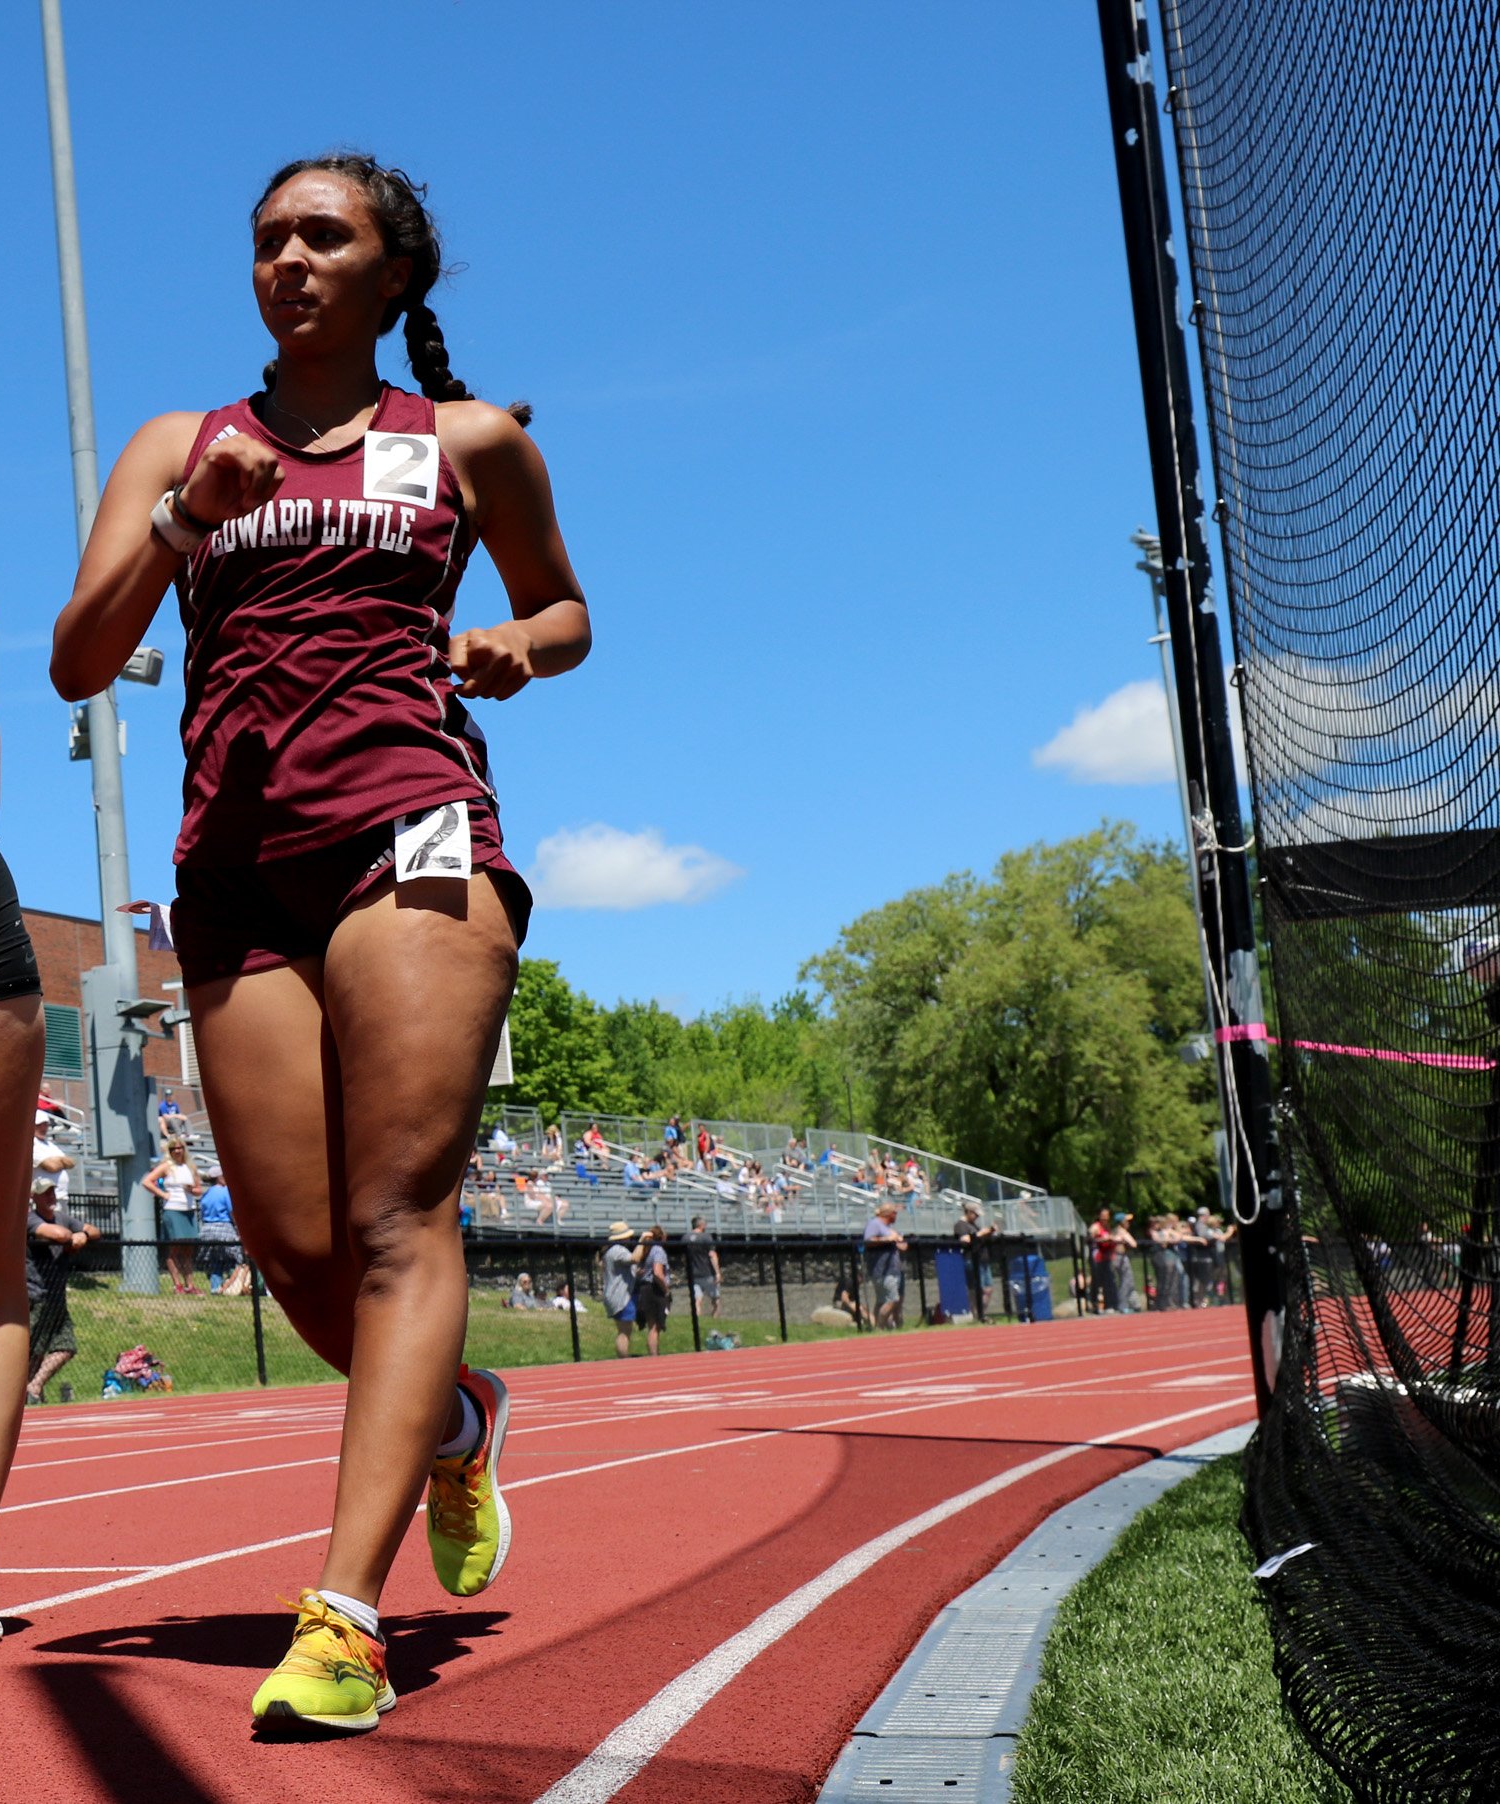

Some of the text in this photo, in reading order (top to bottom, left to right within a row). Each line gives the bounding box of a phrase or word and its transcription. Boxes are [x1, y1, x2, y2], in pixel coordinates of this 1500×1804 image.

[373, 436, 428, 500] 2
[321, 499, 416, 555] LITTLE
[405, 804, 462, 873] 2
